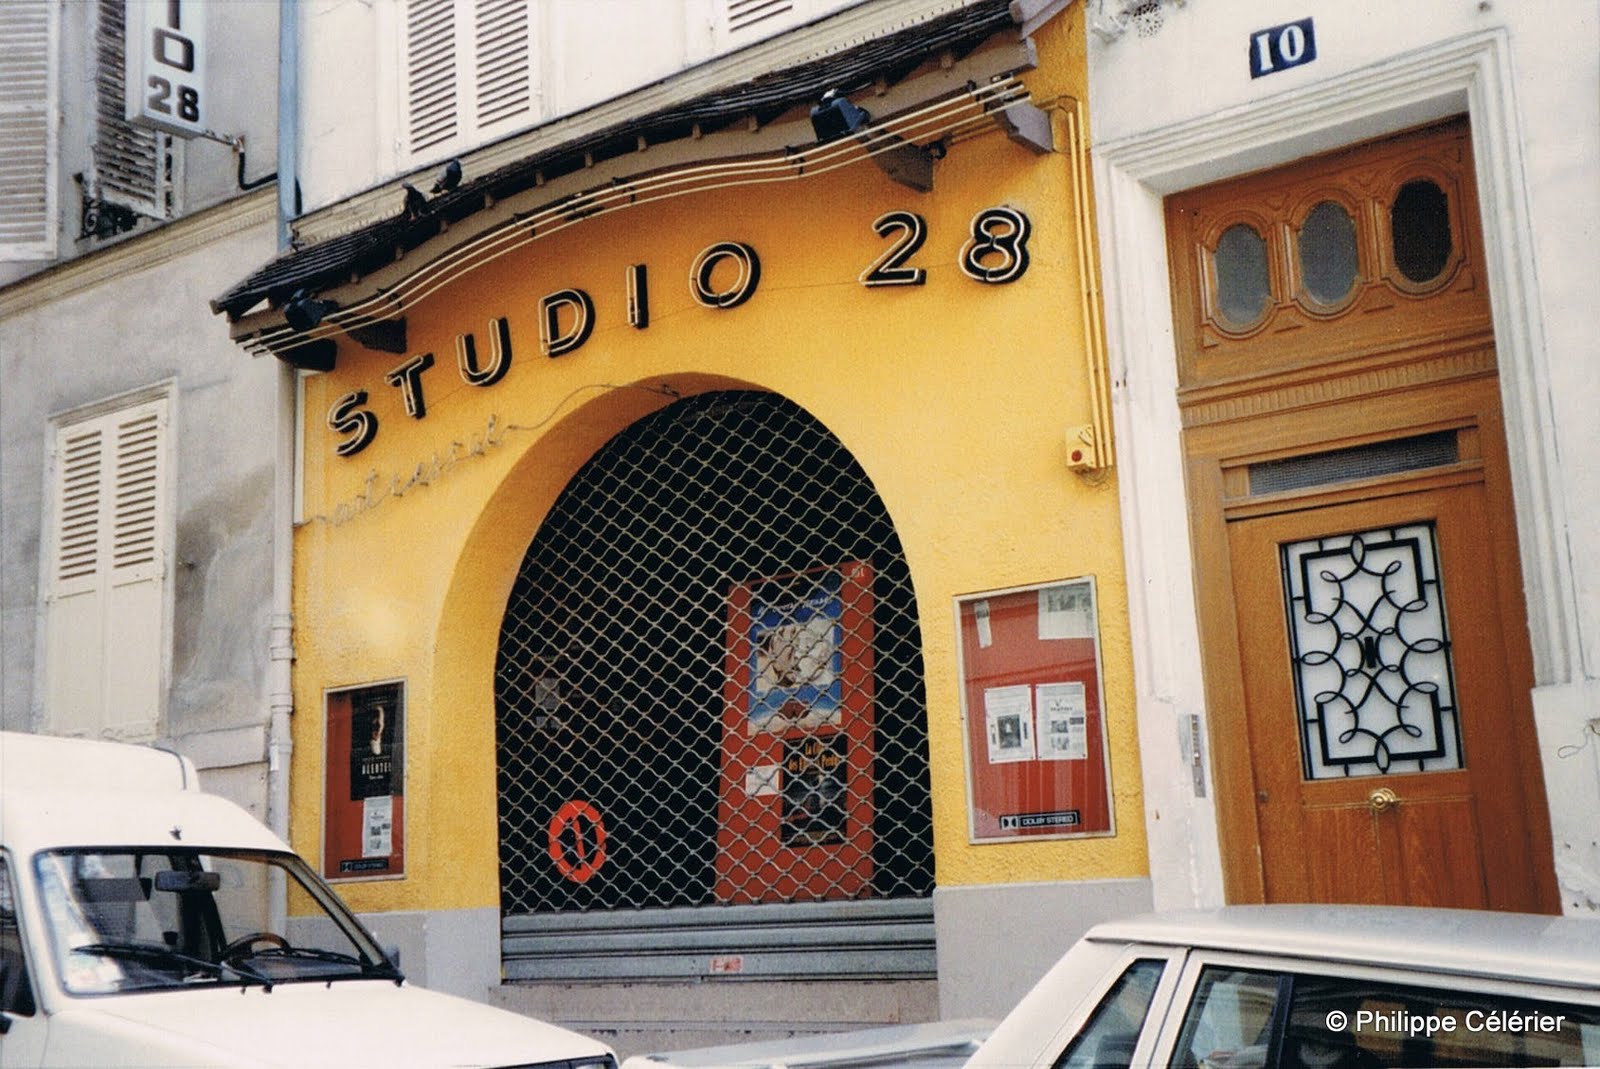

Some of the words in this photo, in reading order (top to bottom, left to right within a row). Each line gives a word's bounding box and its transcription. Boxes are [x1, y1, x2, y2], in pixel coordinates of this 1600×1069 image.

[1256, 25, 1305, 72] 10
[147, 75, 199, 123] 28
[326, 241, 761, 457] STUDIO
[859, 206, 1031, 287] 28
